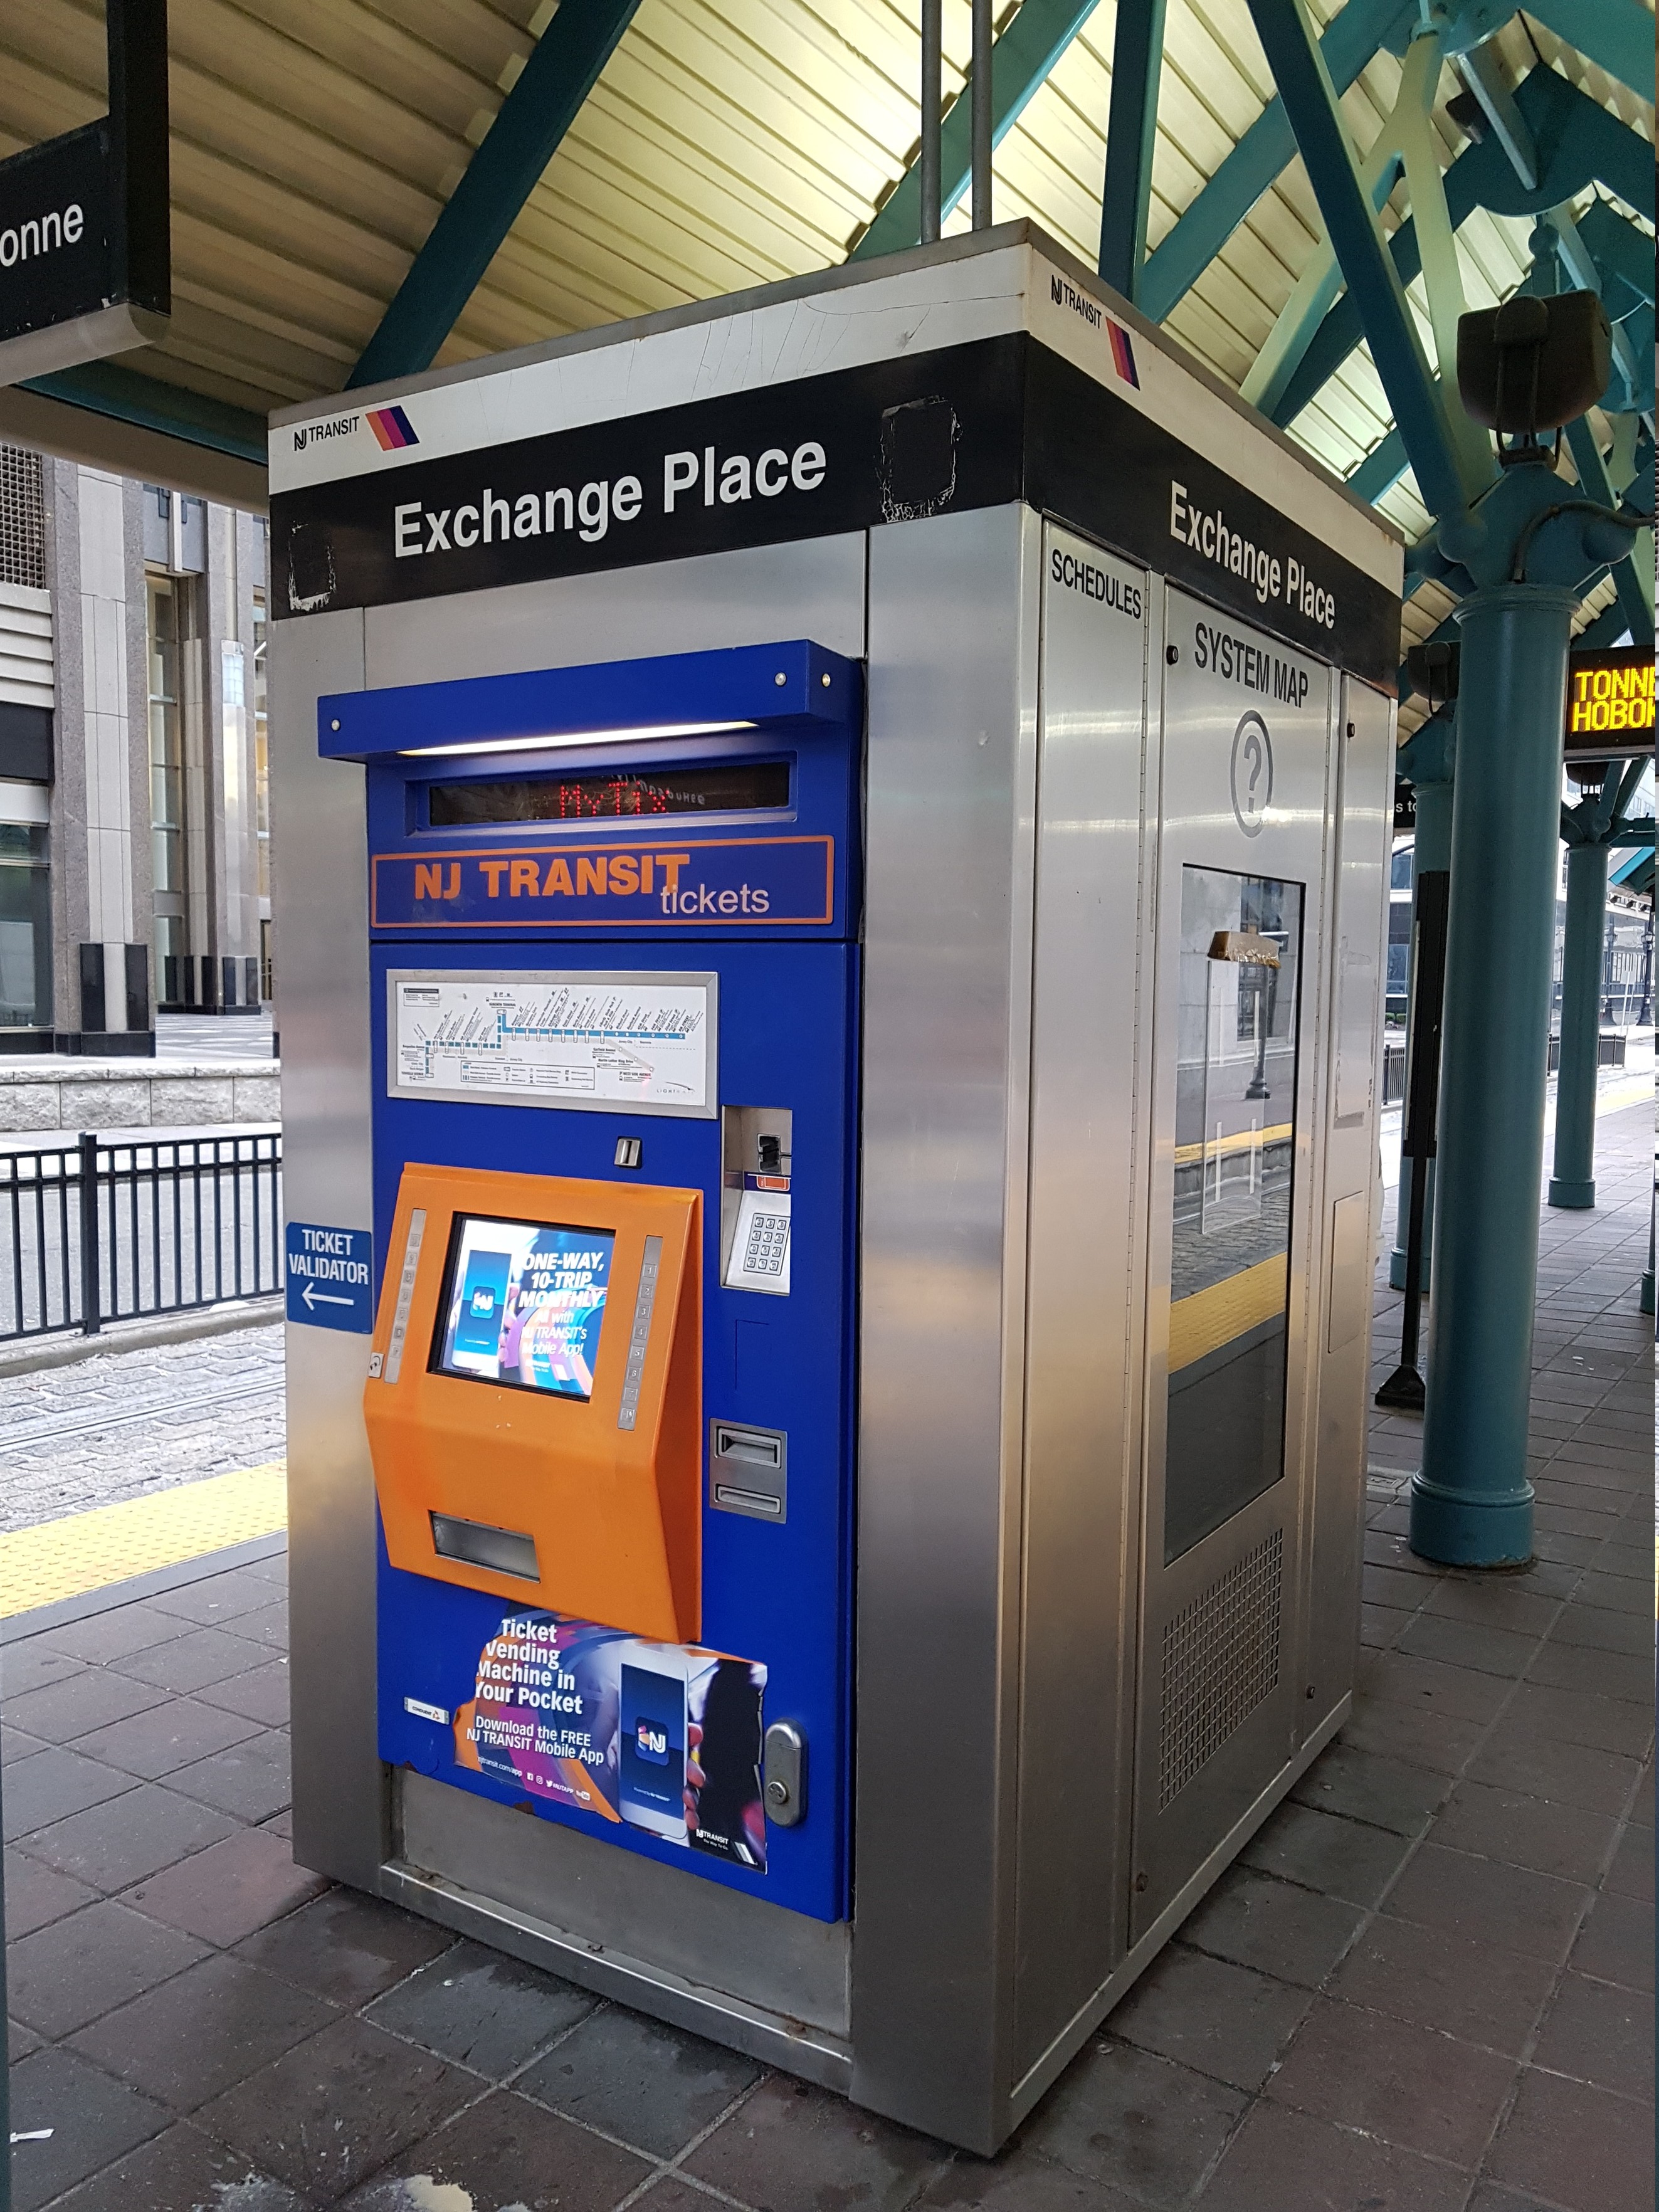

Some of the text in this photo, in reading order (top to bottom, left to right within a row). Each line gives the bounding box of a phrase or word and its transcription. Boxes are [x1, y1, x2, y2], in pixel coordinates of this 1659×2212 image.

[0, 204, 83, 266] onne
[1063, 283, 1102, 329] TRANSIT
[308, 416, 360, 442] TRANSIT
[395, 441, 826, 557] Exchange Place
[1171, 480, 1335, 629] Exchange Place
[1052, 549, 1141, 619] SCHEDULES
[1194, 623, 1309, 708] SYSTEM MAP
[414, 853, 690, 899] NJ TRANSIT
[660, 883, 770, 915] tickets
[302, 1230, 353, 1255] TICKET
[289, 1253, 368, 1285] VALIDATOR
[522, 1252, 604, 1271] ONE-WAY,
[519, 1290, 604, 1307] MONTHLY
[552, 1310, 574, 1323] with
[559, 1343, 584, 1357] App!
[502, 1619, 557, 1643] Ticket
[486, 1640, 561, 1670] Vending
[477, 1660, 575, 1690] Machine in
[475, 1681, 583, 1714] Your Pocket
[466, 1728, 604, 1766] NJ TRANSIT Mobile App
[476, 1715, 591, 1747] Download the FREE
[650, 1732, 666, 1753] NJ
[703, 1830, 729, 1845] TRANSIT
